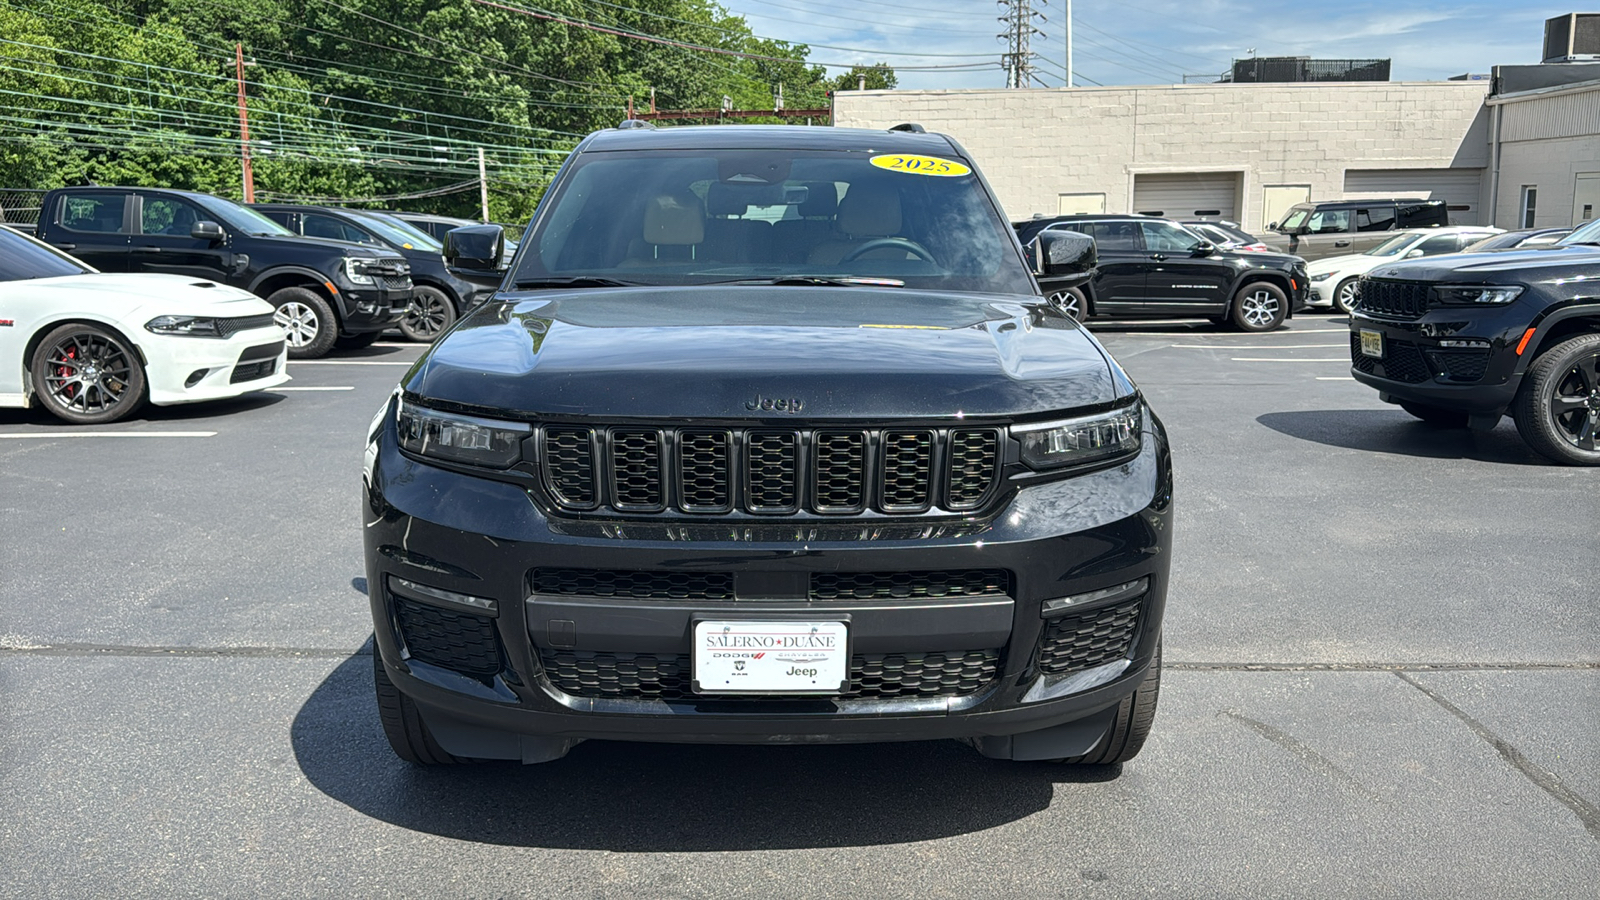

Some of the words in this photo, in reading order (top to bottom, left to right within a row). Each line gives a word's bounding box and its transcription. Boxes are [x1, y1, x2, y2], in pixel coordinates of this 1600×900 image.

[890, 157, 952, 172] 2025
[744, 393, 803, 415] Jeep
[706, 635, 775, 648] SALERNO
[783, 636, 836, 648] DUANE
[786, 666, 818, 678] Jeep
